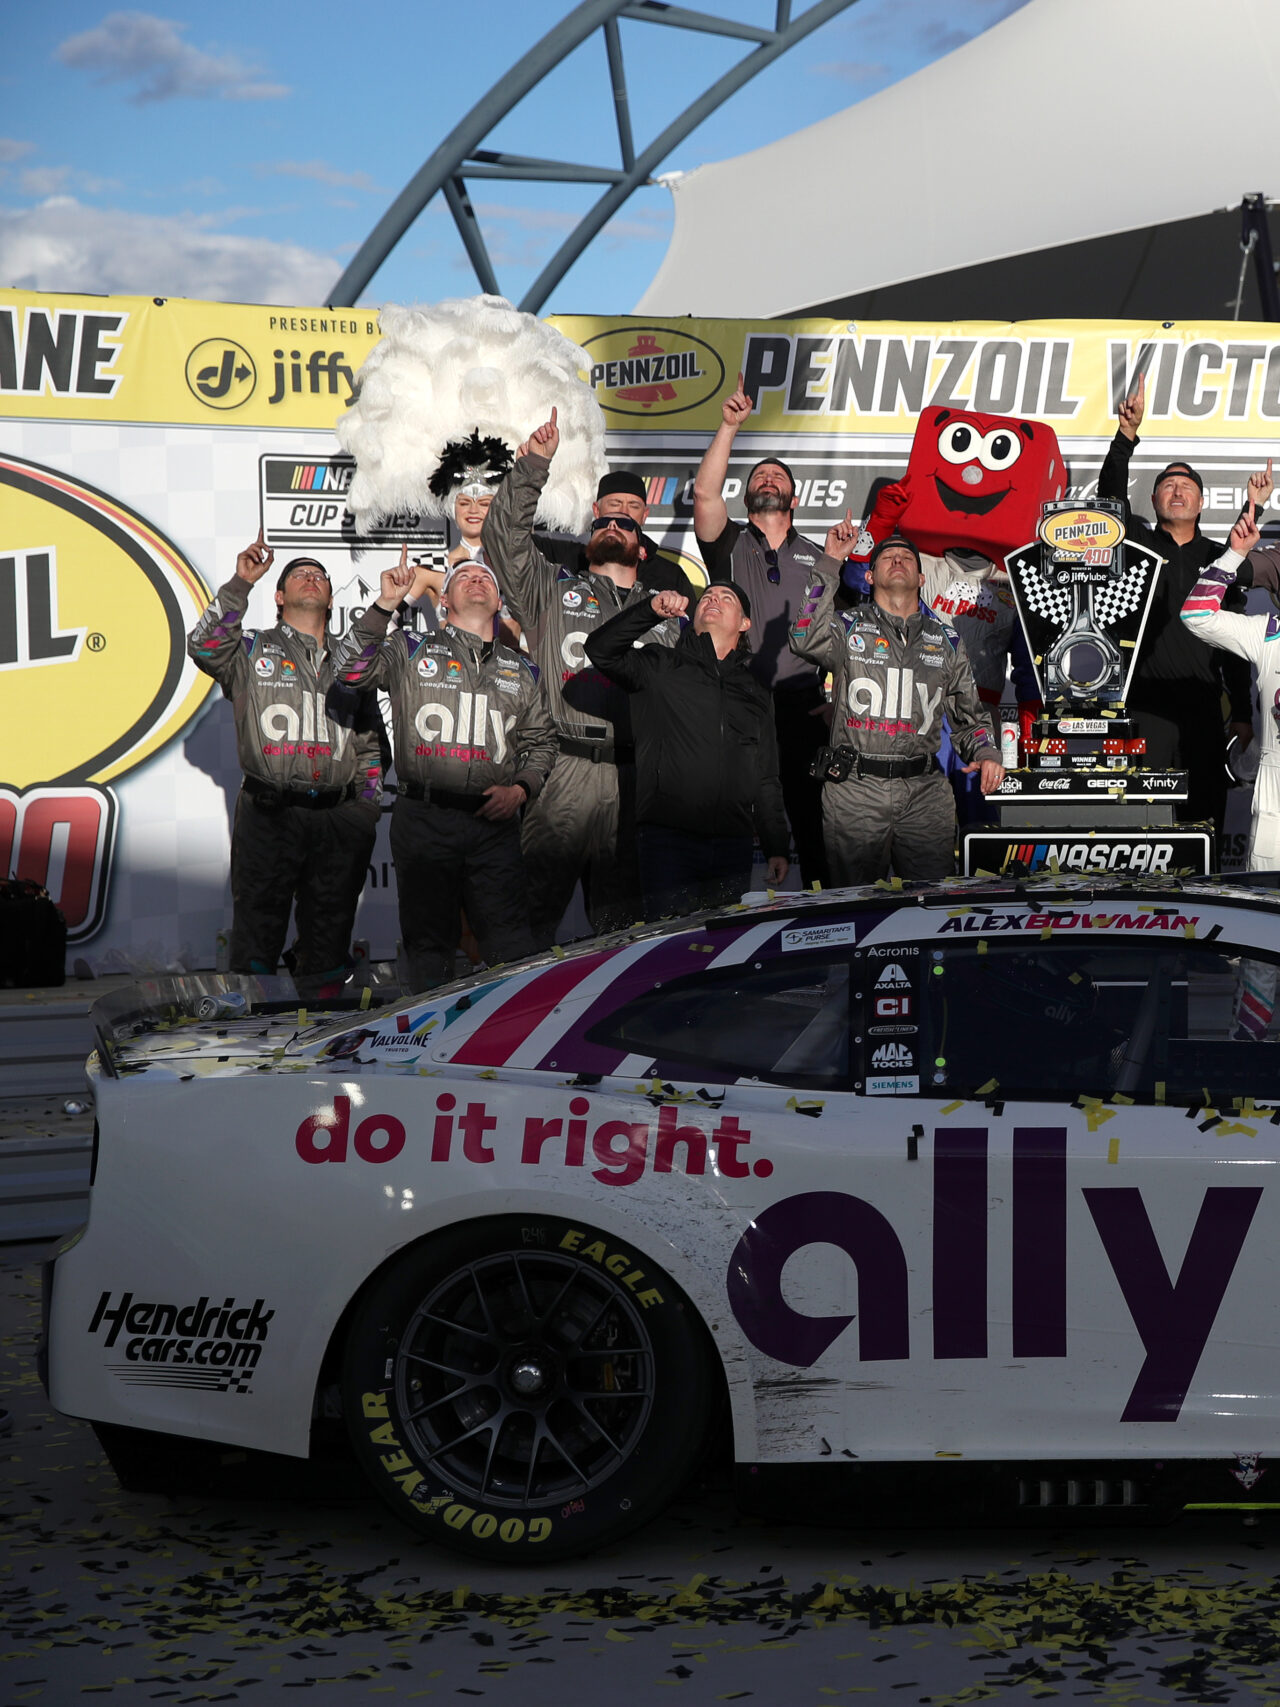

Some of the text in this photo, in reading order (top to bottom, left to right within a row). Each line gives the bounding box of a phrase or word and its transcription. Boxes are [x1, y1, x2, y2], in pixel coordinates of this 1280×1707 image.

[269, 316, 358, 335] PRESENTED
[591, 350, 703, 389] PENNZOIL
[743, 335, 1084, 417] PENNZOIL
[289, 504, 339, 527] CUP
[1055, 521, 1109, 541] PENNZOIL
[1082, 548, 1111, 565] 400
[1071, 572, 1107, 583] jiffy lube
[848, 667, 942, 735] ally
[260, 691, 351, 762] ally
[415, 691, 517, 764] ally
[847, 717, 861, 729] do
[864, 717, 876, 730] it
[263, 743, 281, 756] do
[283, 742, 295, 756] it
[416, 742, 491, 763] do it right.
[1087, 779, 1127, 788] GEICO
[1142, 777, 1179, 791] xfinity
[1046, 844, 1174, 874] NASCAR
[802, 925, 852, 937] SAMARITAN'S
[805, 933, 831, 942] PURSE
[867, 946, 920, 958] Acronis
[873, 981, 913, 990] AXALTA
[876, 997, 910, 1016] CI
[1044, 1003, 1077, 1025] ally
[370, 1032, 432, 1049] VALVOLINE
[871, 1042, 913, 1061] MAC
[871, 1061, 914, 1069] TOOLS
[871, 1081, 914, 1090] SIEMENS
[295, 1092, 775, 1187] do it right.
[559, 1229, 665, 1309] EAGLE
[727, 1126, 1265, 1423] ally
[87, 1290, 276, 1348] Hendrick
[125, 1337, 263, 1369] cars.com
[361, 1391, 553, 1543] GOODYEAR
